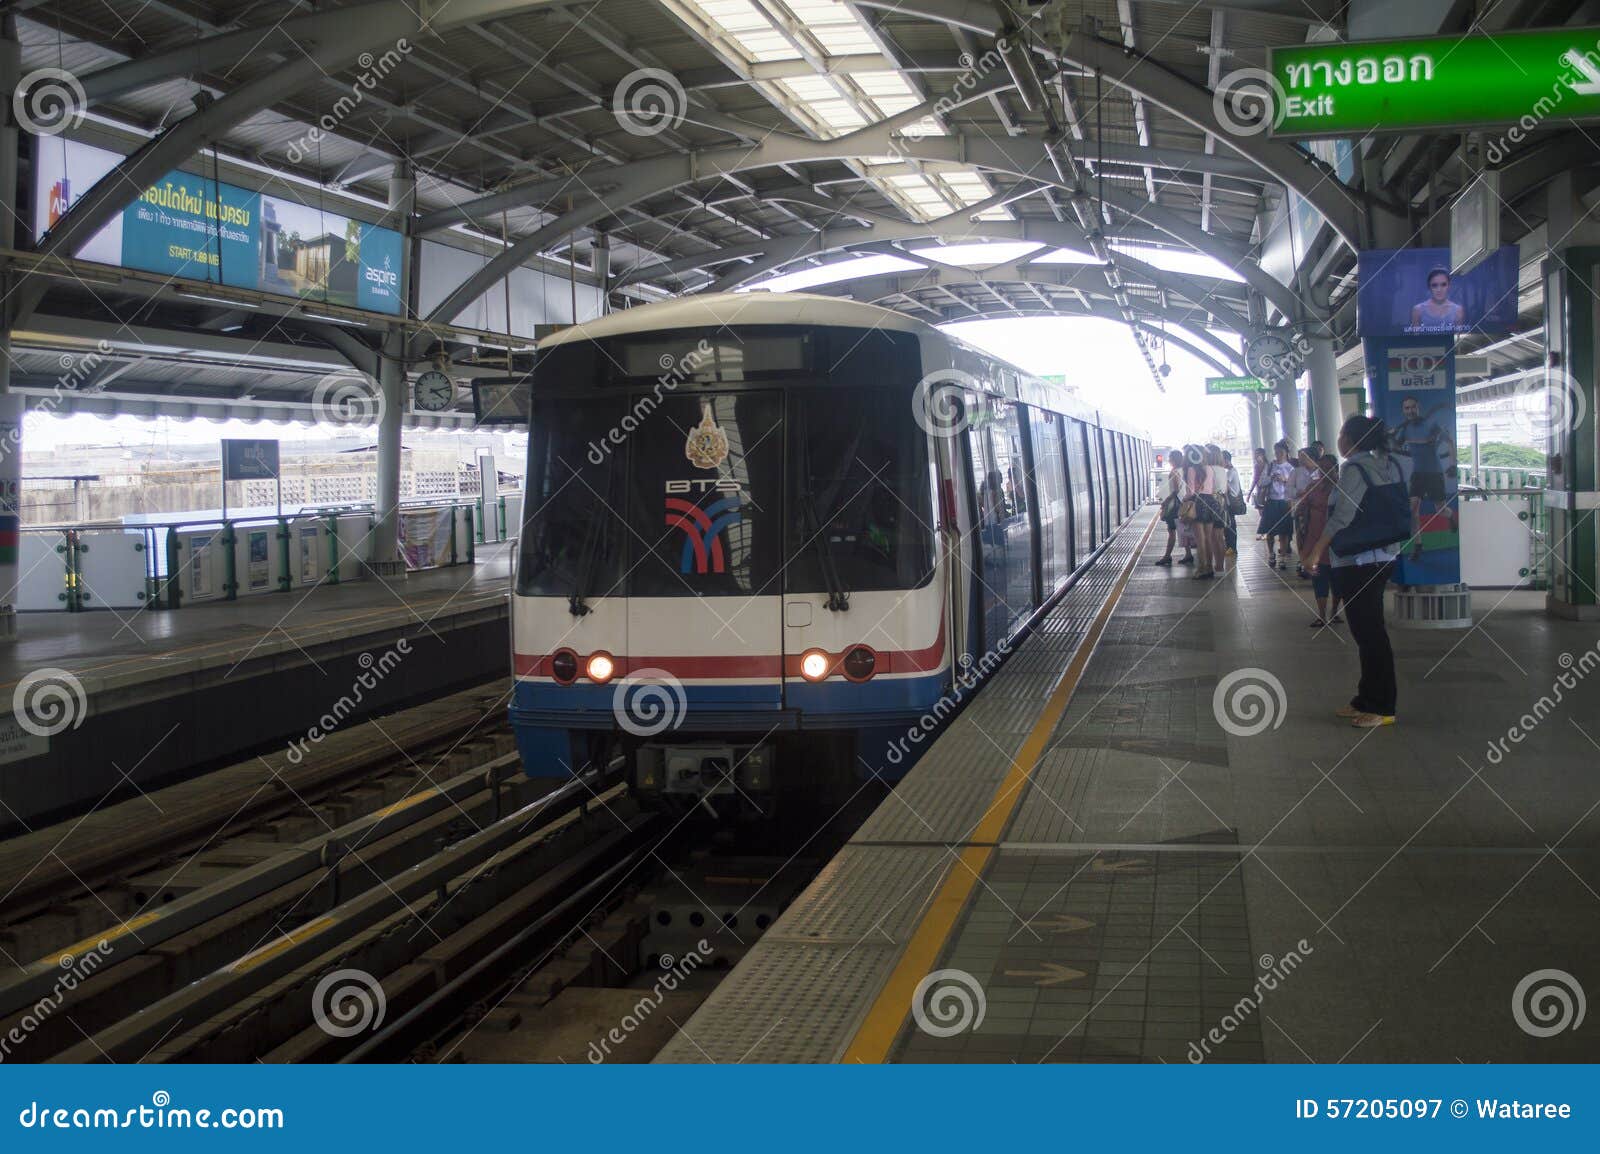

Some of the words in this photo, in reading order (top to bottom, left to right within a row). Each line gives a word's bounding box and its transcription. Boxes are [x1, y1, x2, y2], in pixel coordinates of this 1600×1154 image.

[1286, 54, 1433, 88] ทางออก
[1286, 96, 1334, 118] Exit
[168, 245, 192, 261] START
[665, 479, 742, 493] BTS
